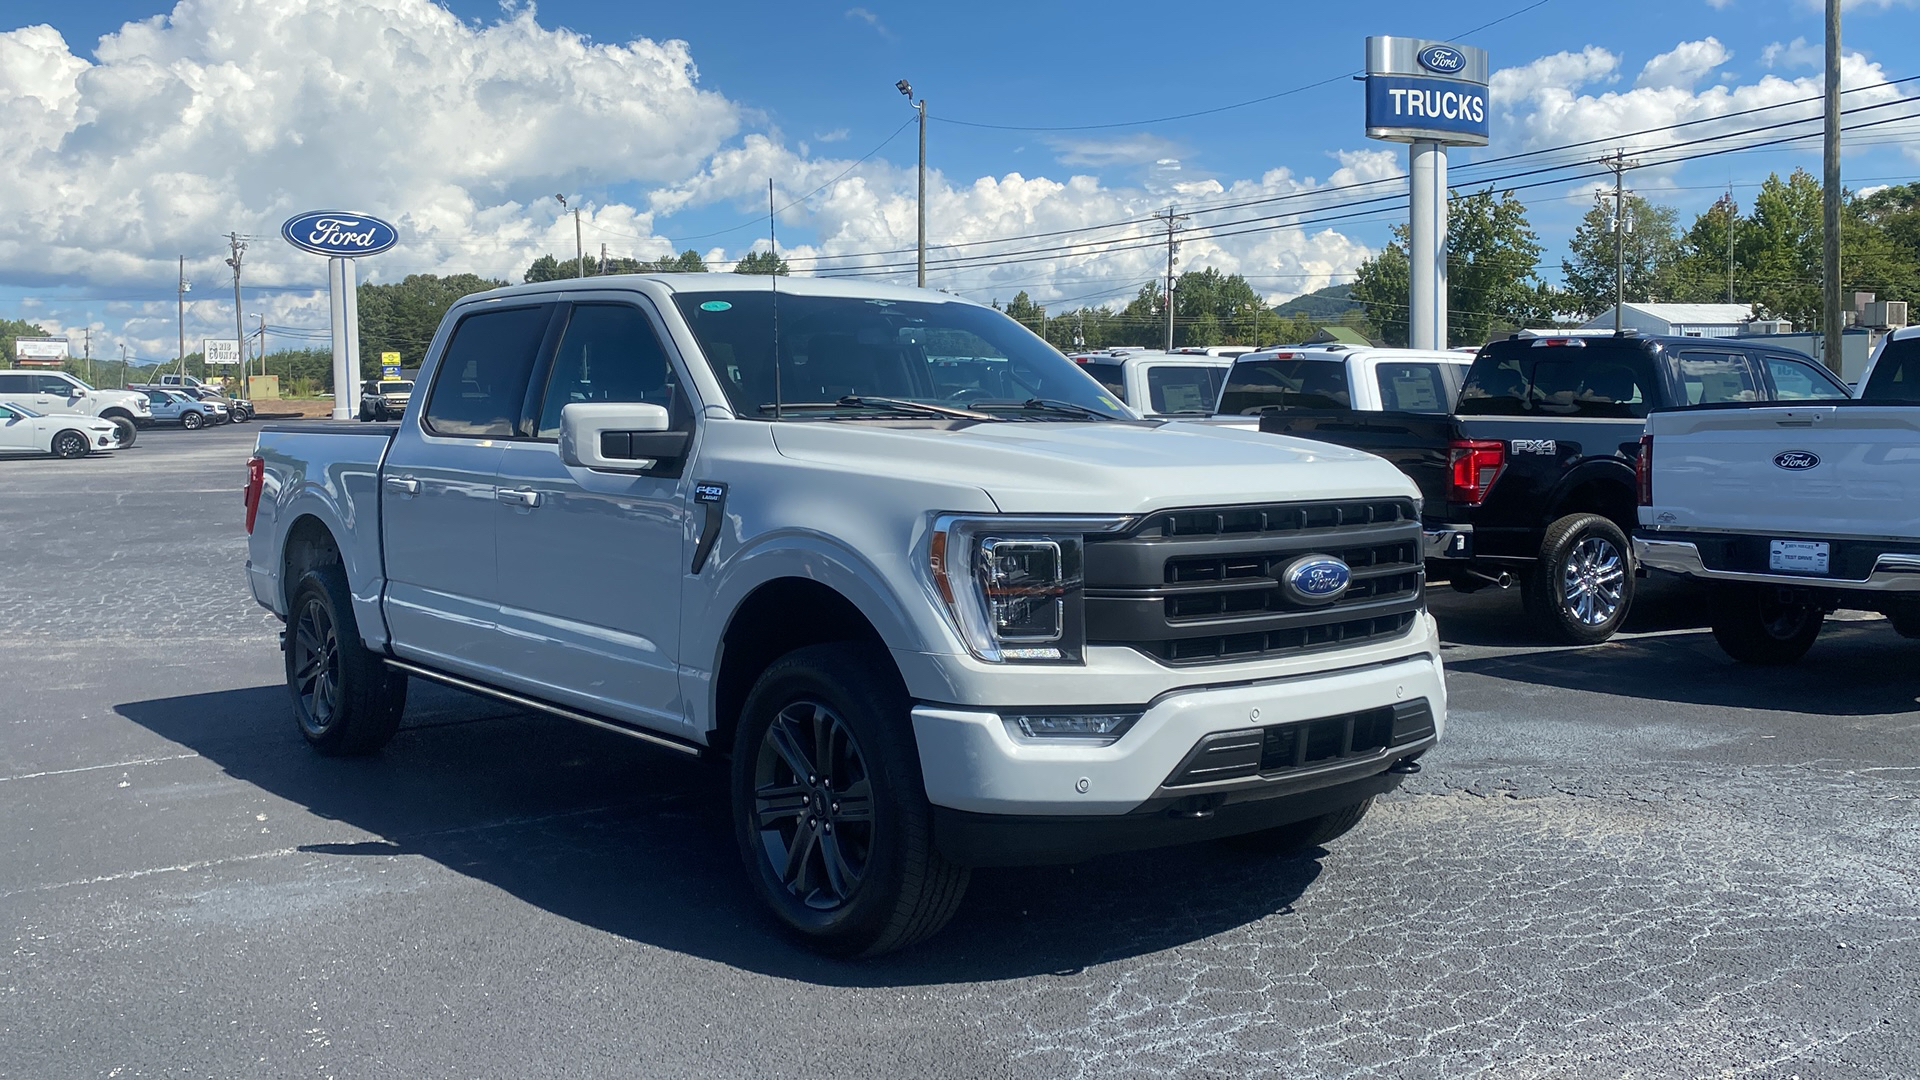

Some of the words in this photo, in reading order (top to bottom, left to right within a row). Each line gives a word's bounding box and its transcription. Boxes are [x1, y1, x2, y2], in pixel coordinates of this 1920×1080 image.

[1431, 50, 1458, 69] Ford
[1388, 89, 1484, 123] TRUCKS
[309, 218, 377, 247] Ford
[209, 351, 239, 360] COUNTR
[1511, 439, 1557, 455] FX4
[1780, 453, 1811, 467] Ford
[1308, 569, 1340, 590] Ford
